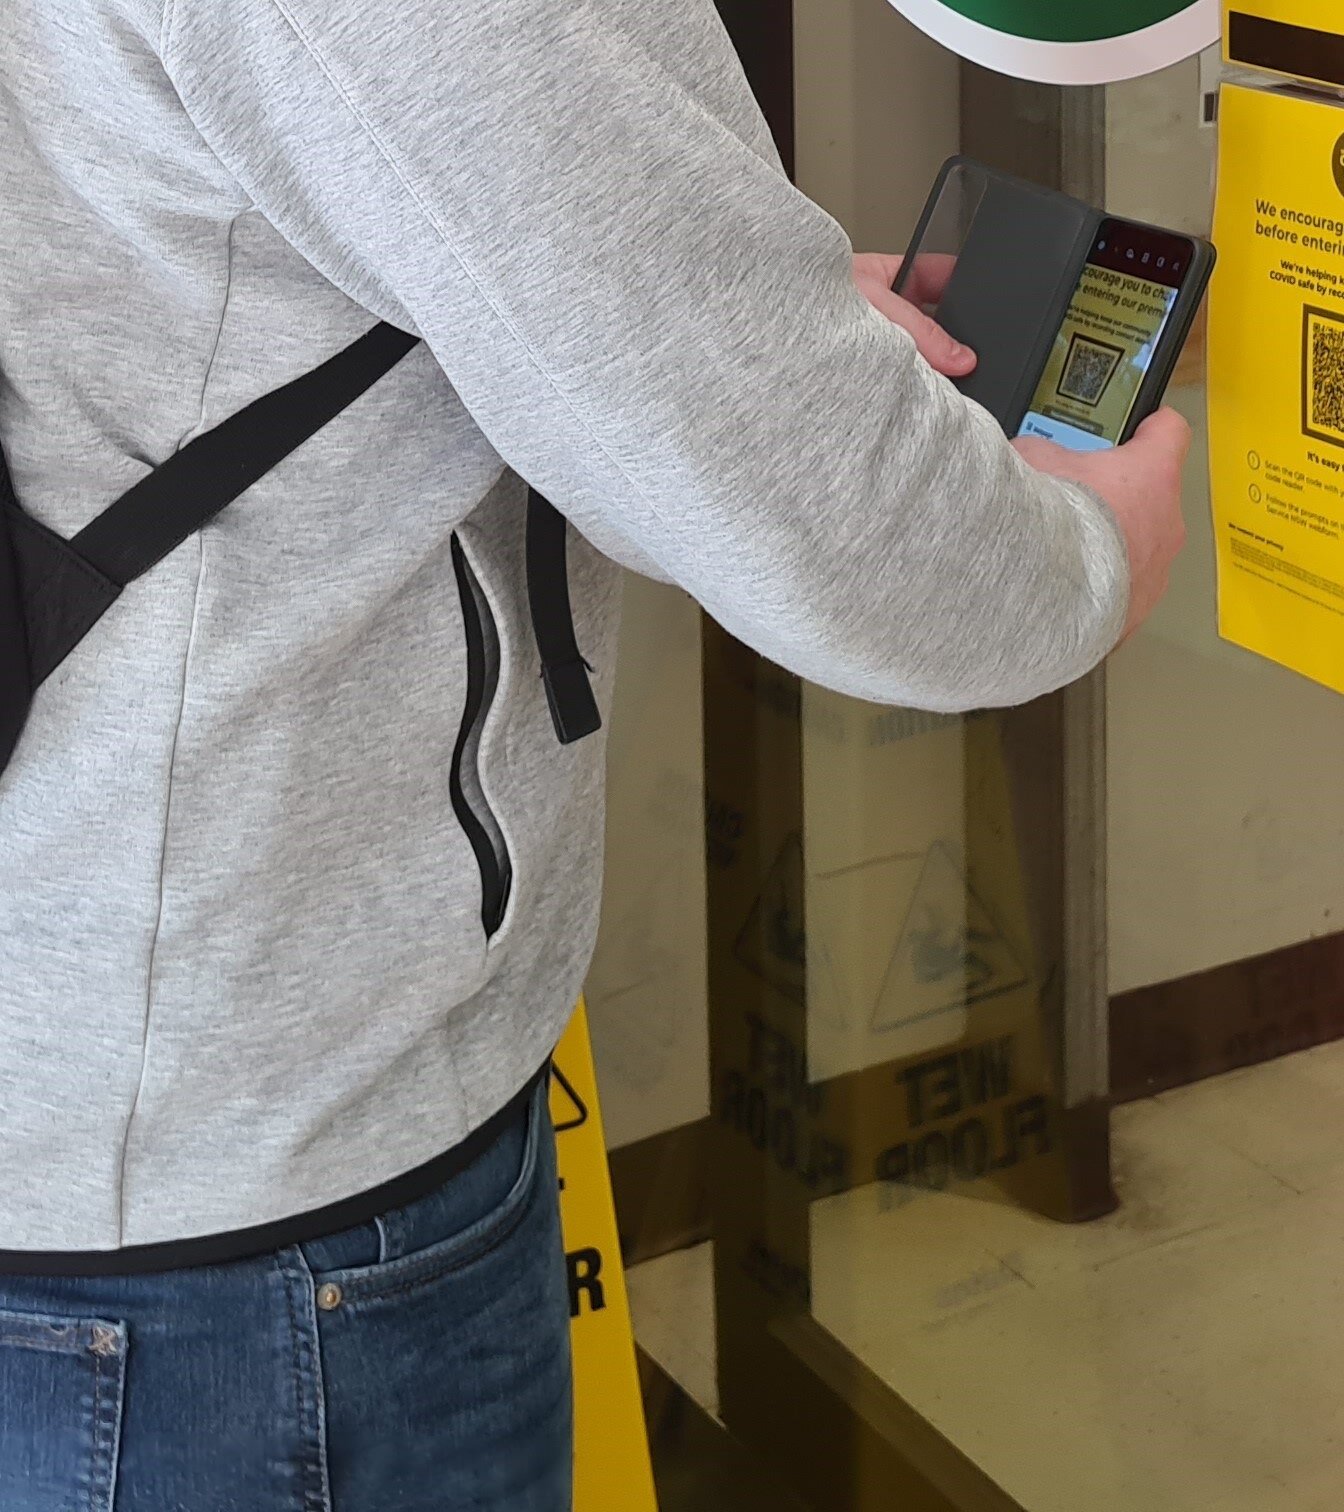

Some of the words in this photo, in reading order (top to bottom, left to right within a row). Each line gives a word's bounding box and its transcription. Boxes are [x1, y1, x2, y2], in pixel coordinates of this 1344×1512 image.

[1256, 199, 1276, 217] We
[1255, 220, 1298, 244] before
[1269, 269, 1296, 285] COVID
[1297, 277, 1315, 291] safe
[1316, 281, 1327, 296] by
[1280, 259, 1304, 275] We're
[1306, 265, 1337, 285] helping
[1082, 284, 1121, 306] entering
[1121, 296, 1137, 308] our
[1120, 278, 1140, 292] you
[1141, 283, 1151, 296] to
[1307, 451, 1319, 465] It's
[1321, 457, 1340, 473] easy
